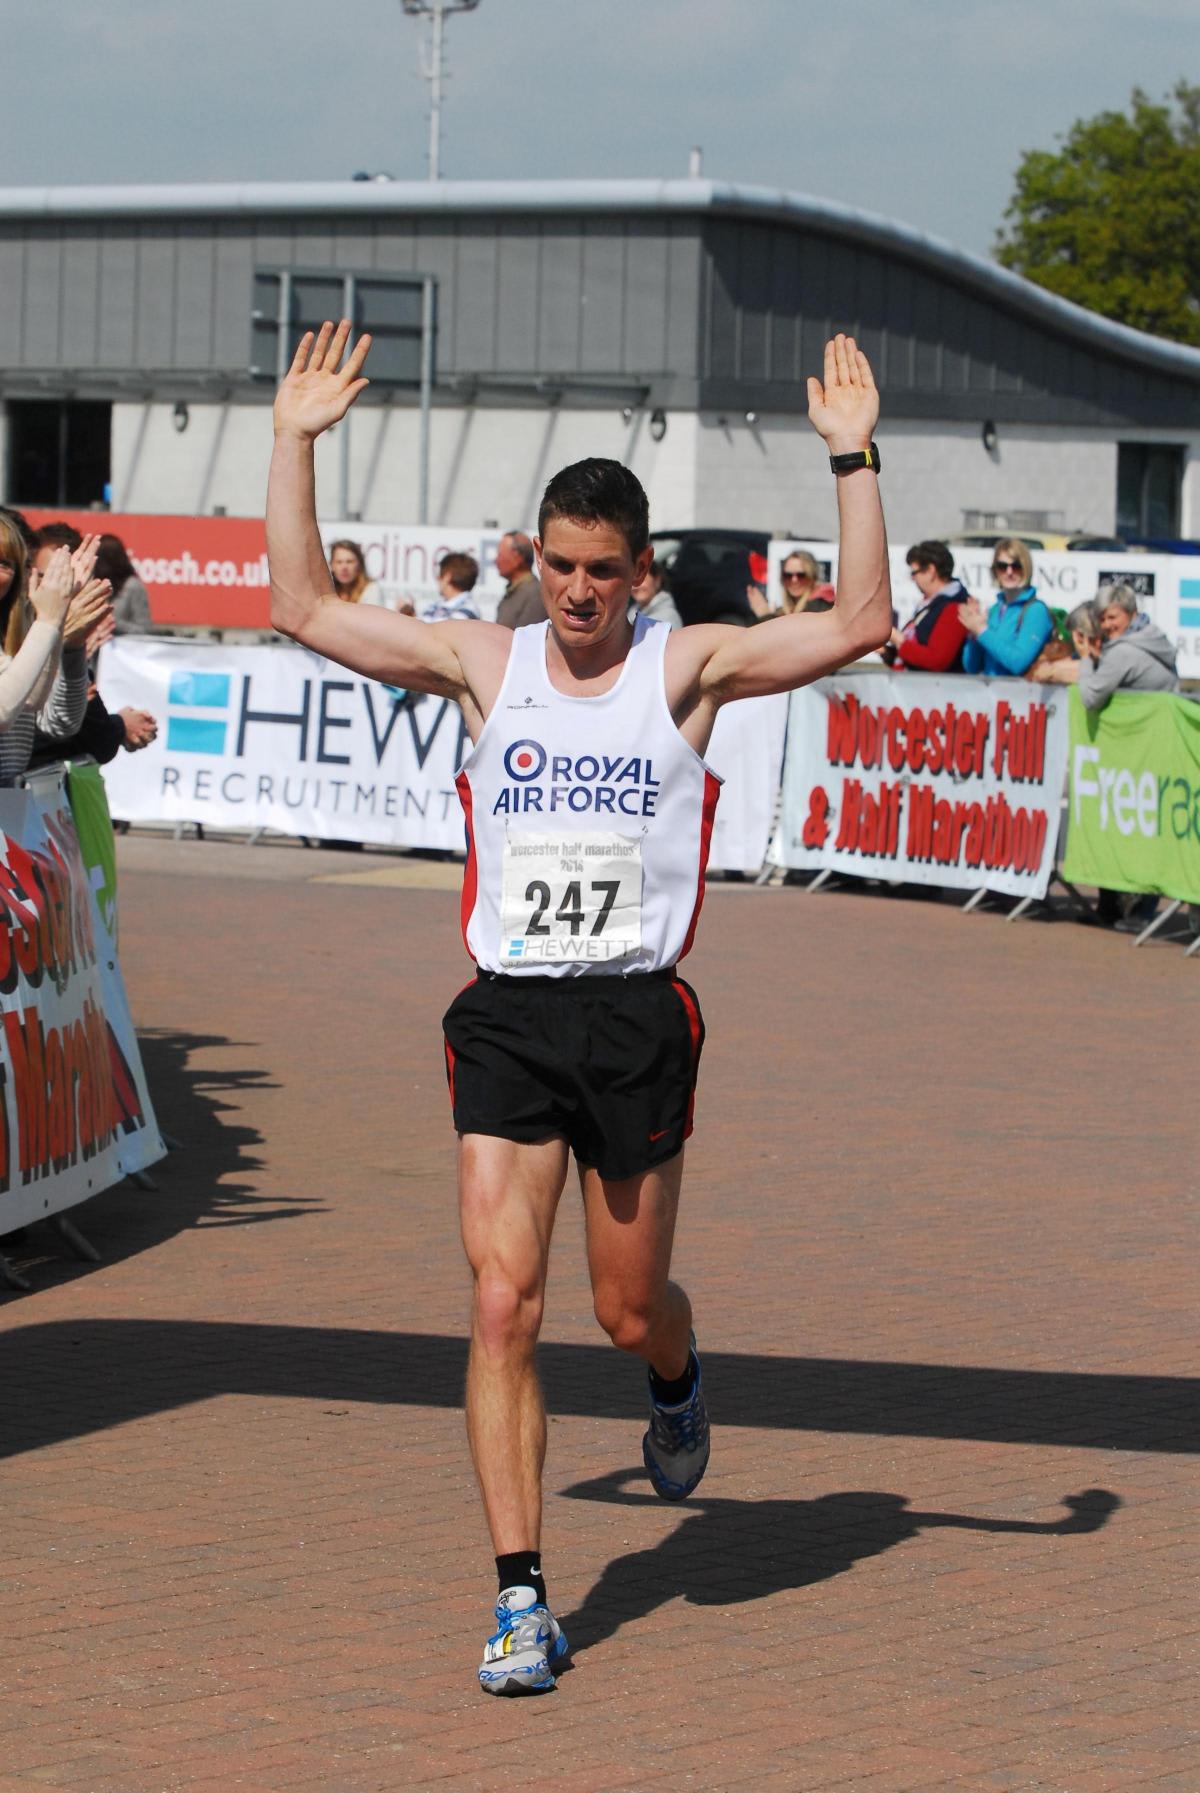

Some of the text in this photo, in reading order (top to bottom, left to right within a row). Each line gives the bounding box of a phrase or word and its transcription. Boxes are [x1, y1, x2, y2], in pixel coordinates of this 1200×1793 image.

[827, 691, 1048, 785] Worcester Full
[551, 755, 661, 786] ROYAL
[161, 766, 457, 822] RECRUITMENT
[493, 786, 660, 817] AIR FORCE
[562, 842, 582, 856] half
[802, 778, 1048, 877] & Half Marathon
[525, 880, 621, 937] 247
[524, 939, 633, 958] HEWETT
